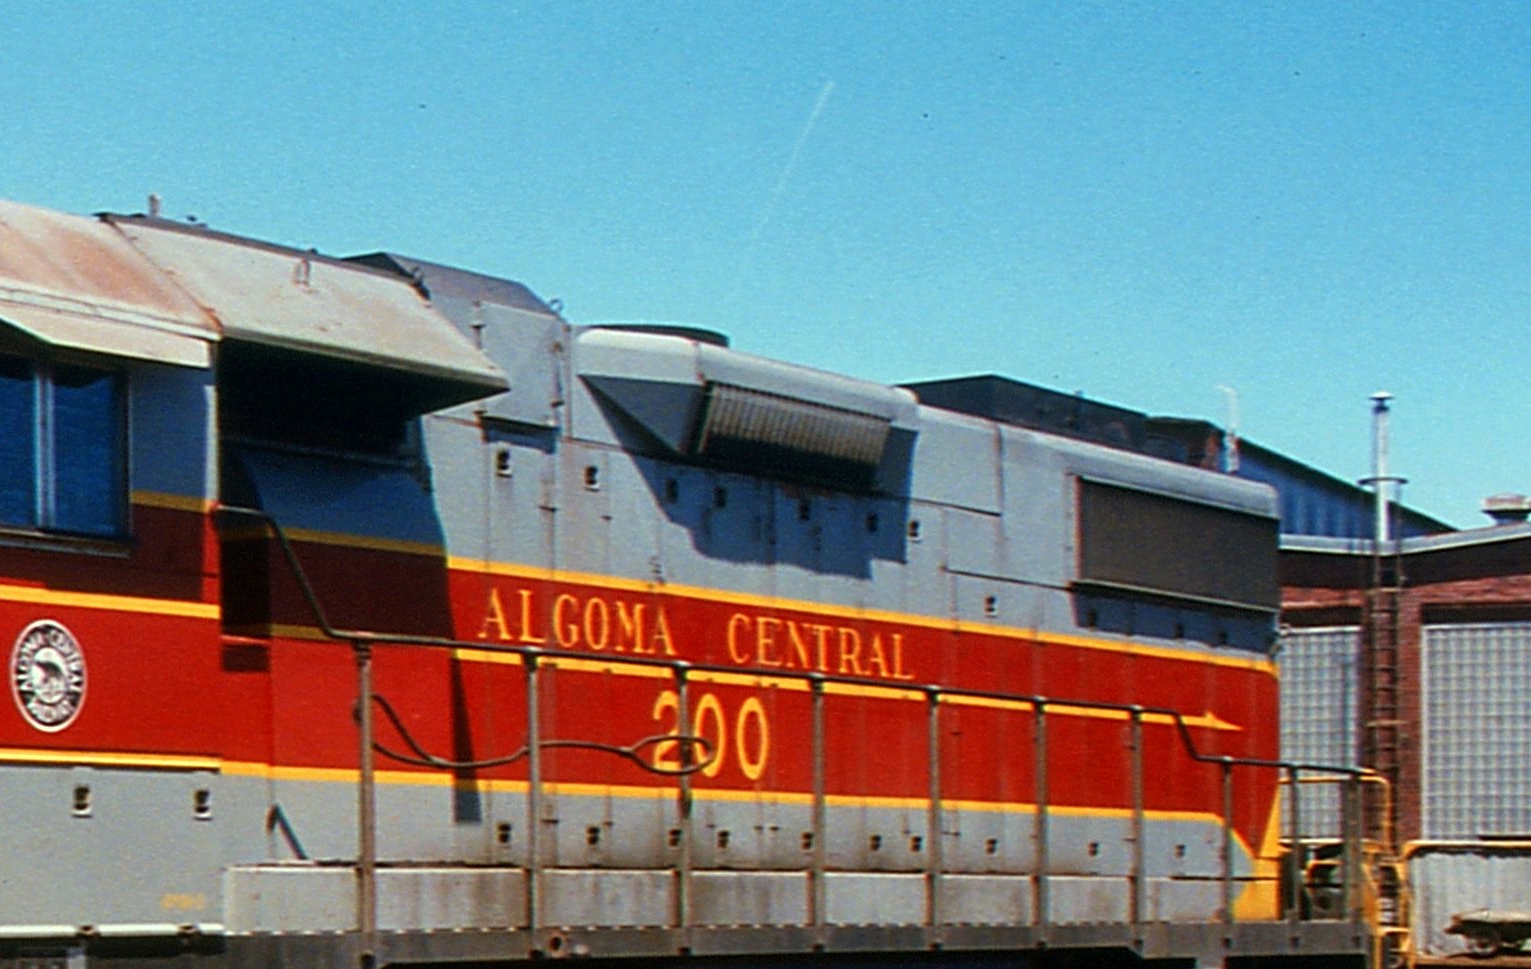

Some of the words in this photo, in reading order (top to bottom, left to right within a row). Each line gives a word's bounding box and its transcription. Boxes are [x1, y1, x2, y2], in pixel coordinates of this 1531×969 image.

[478, 588, 676, 656] ALGOMA
[728, 613, 915, 680] CENTRAL
[653, 690, 769, 780] 200
